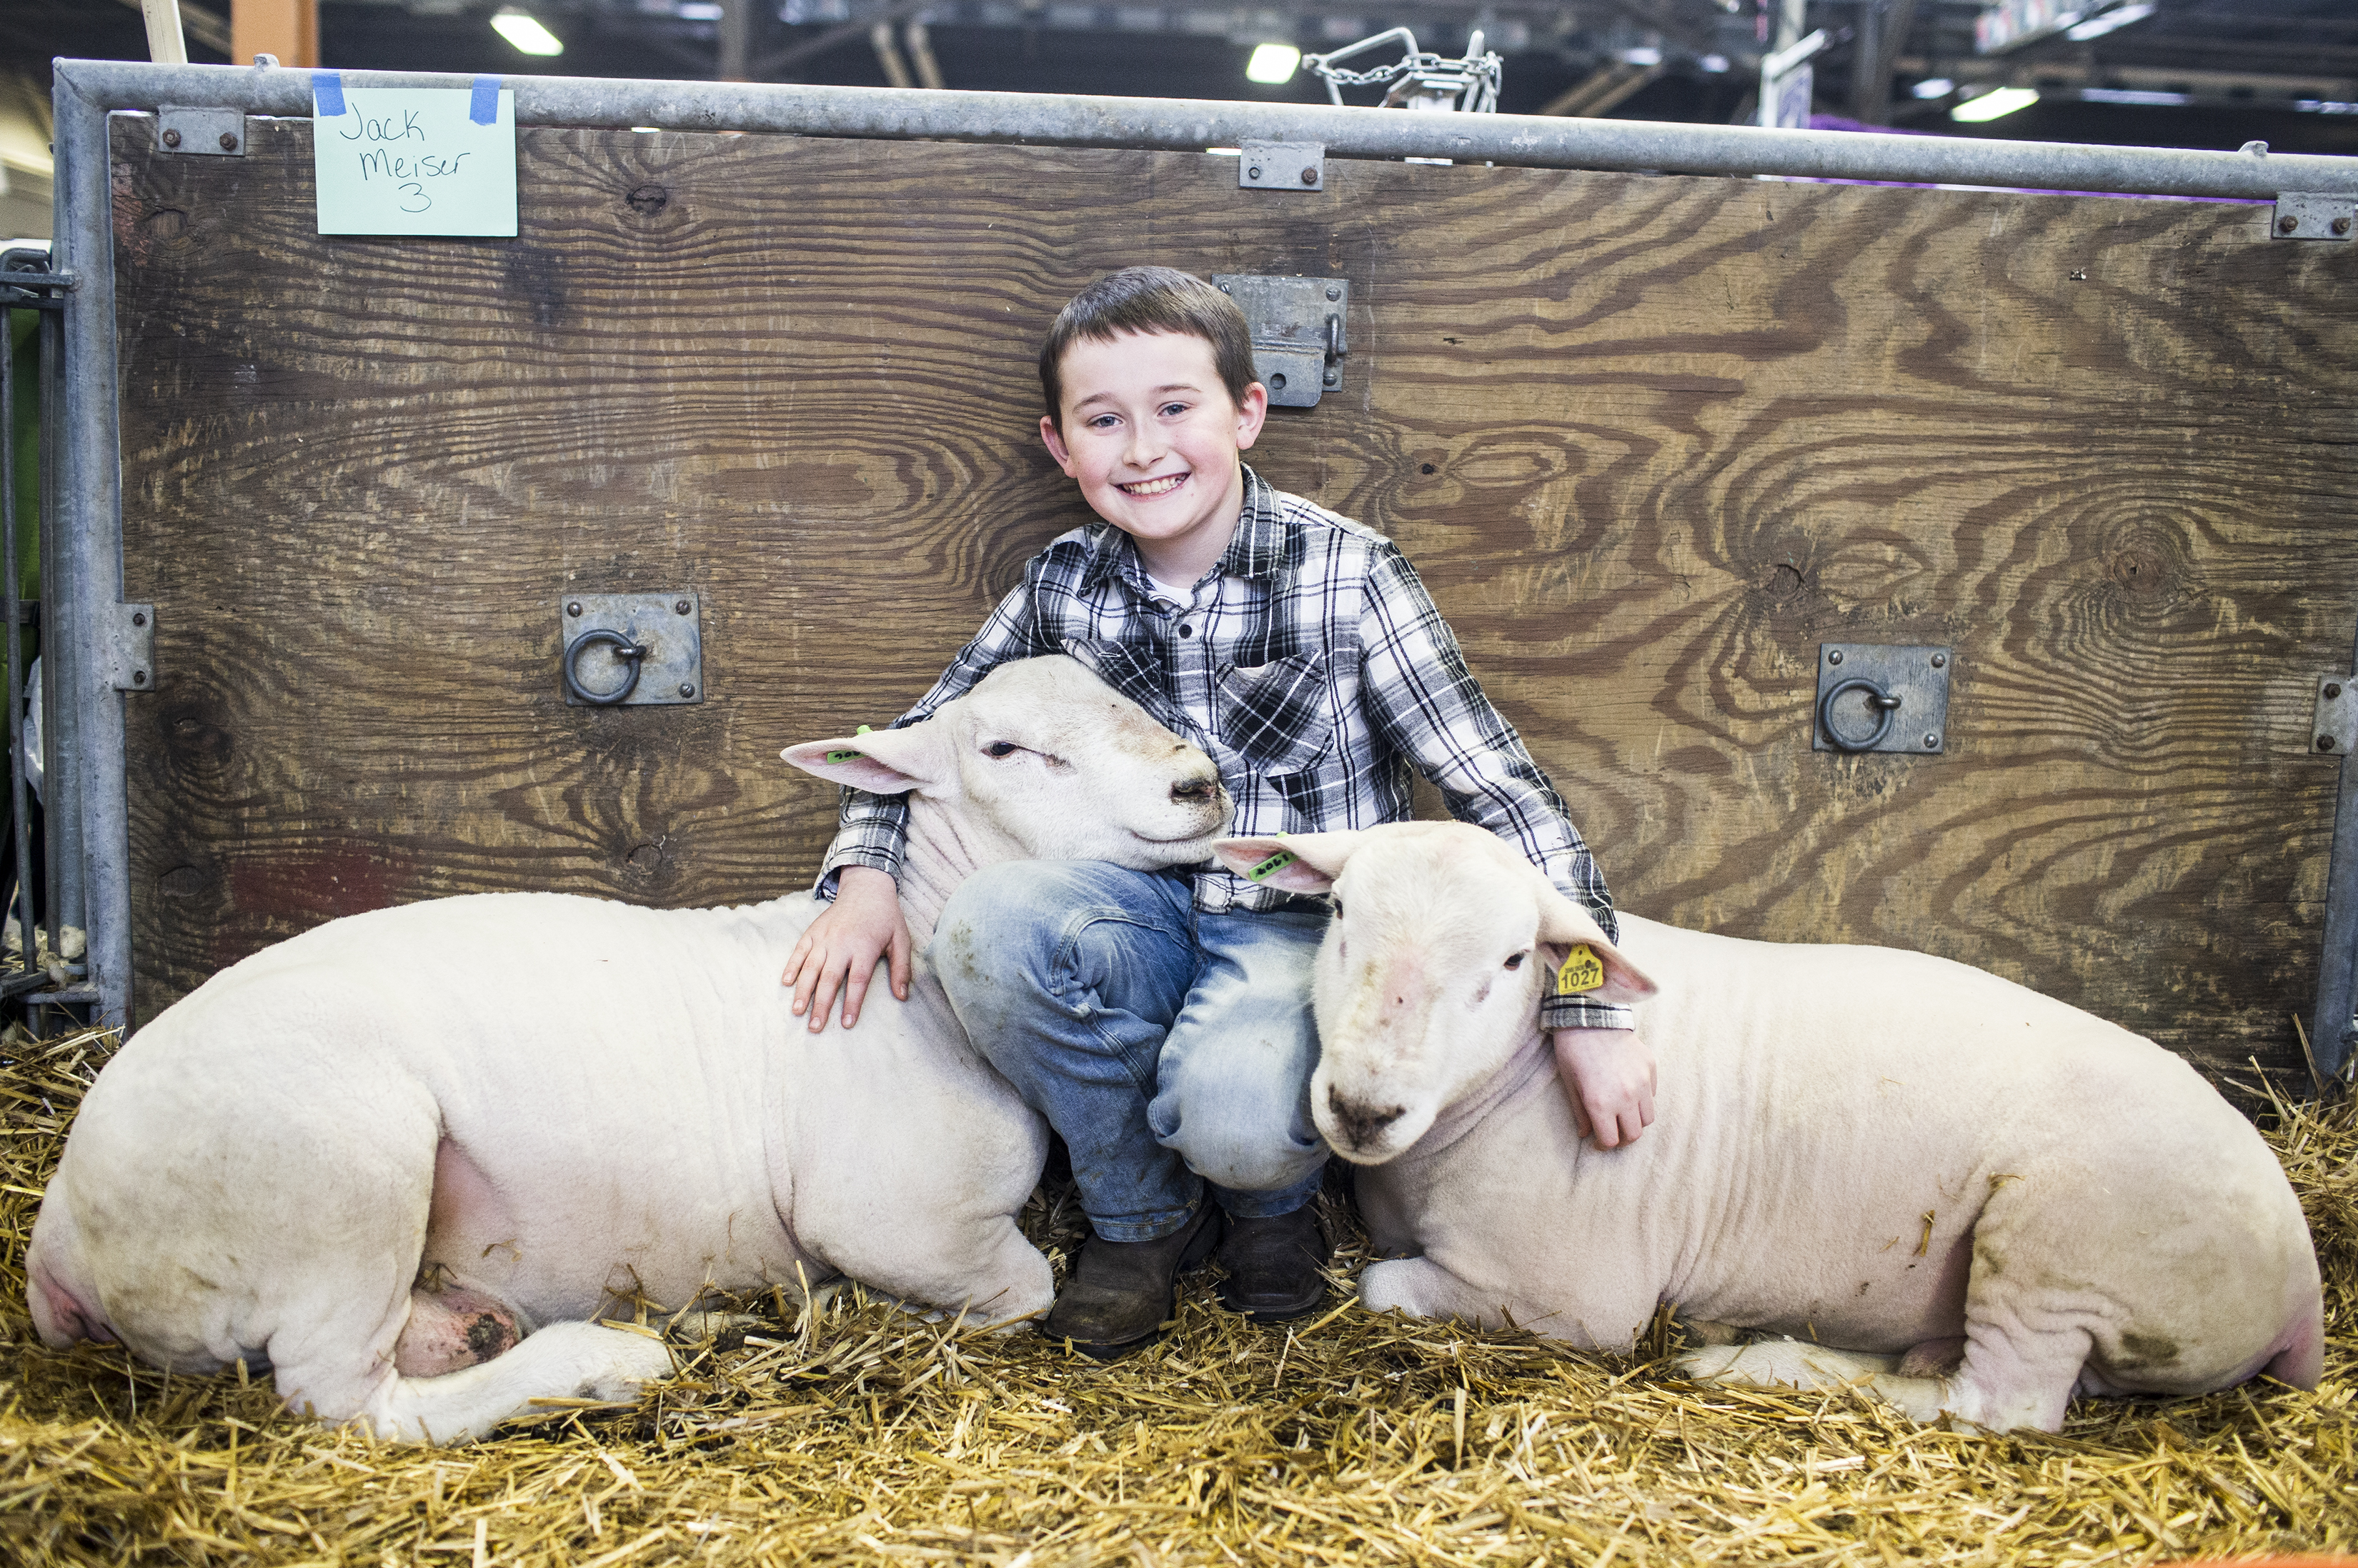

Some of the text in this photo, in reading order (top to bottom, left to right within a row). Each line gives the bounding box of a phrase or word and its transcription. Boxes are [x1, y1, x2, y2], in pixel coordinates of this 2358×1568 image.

[339, 102, 424, 141] Jack
[398, 182, 432, 213] 3
[1561, 967, 1600, 989] 1027
